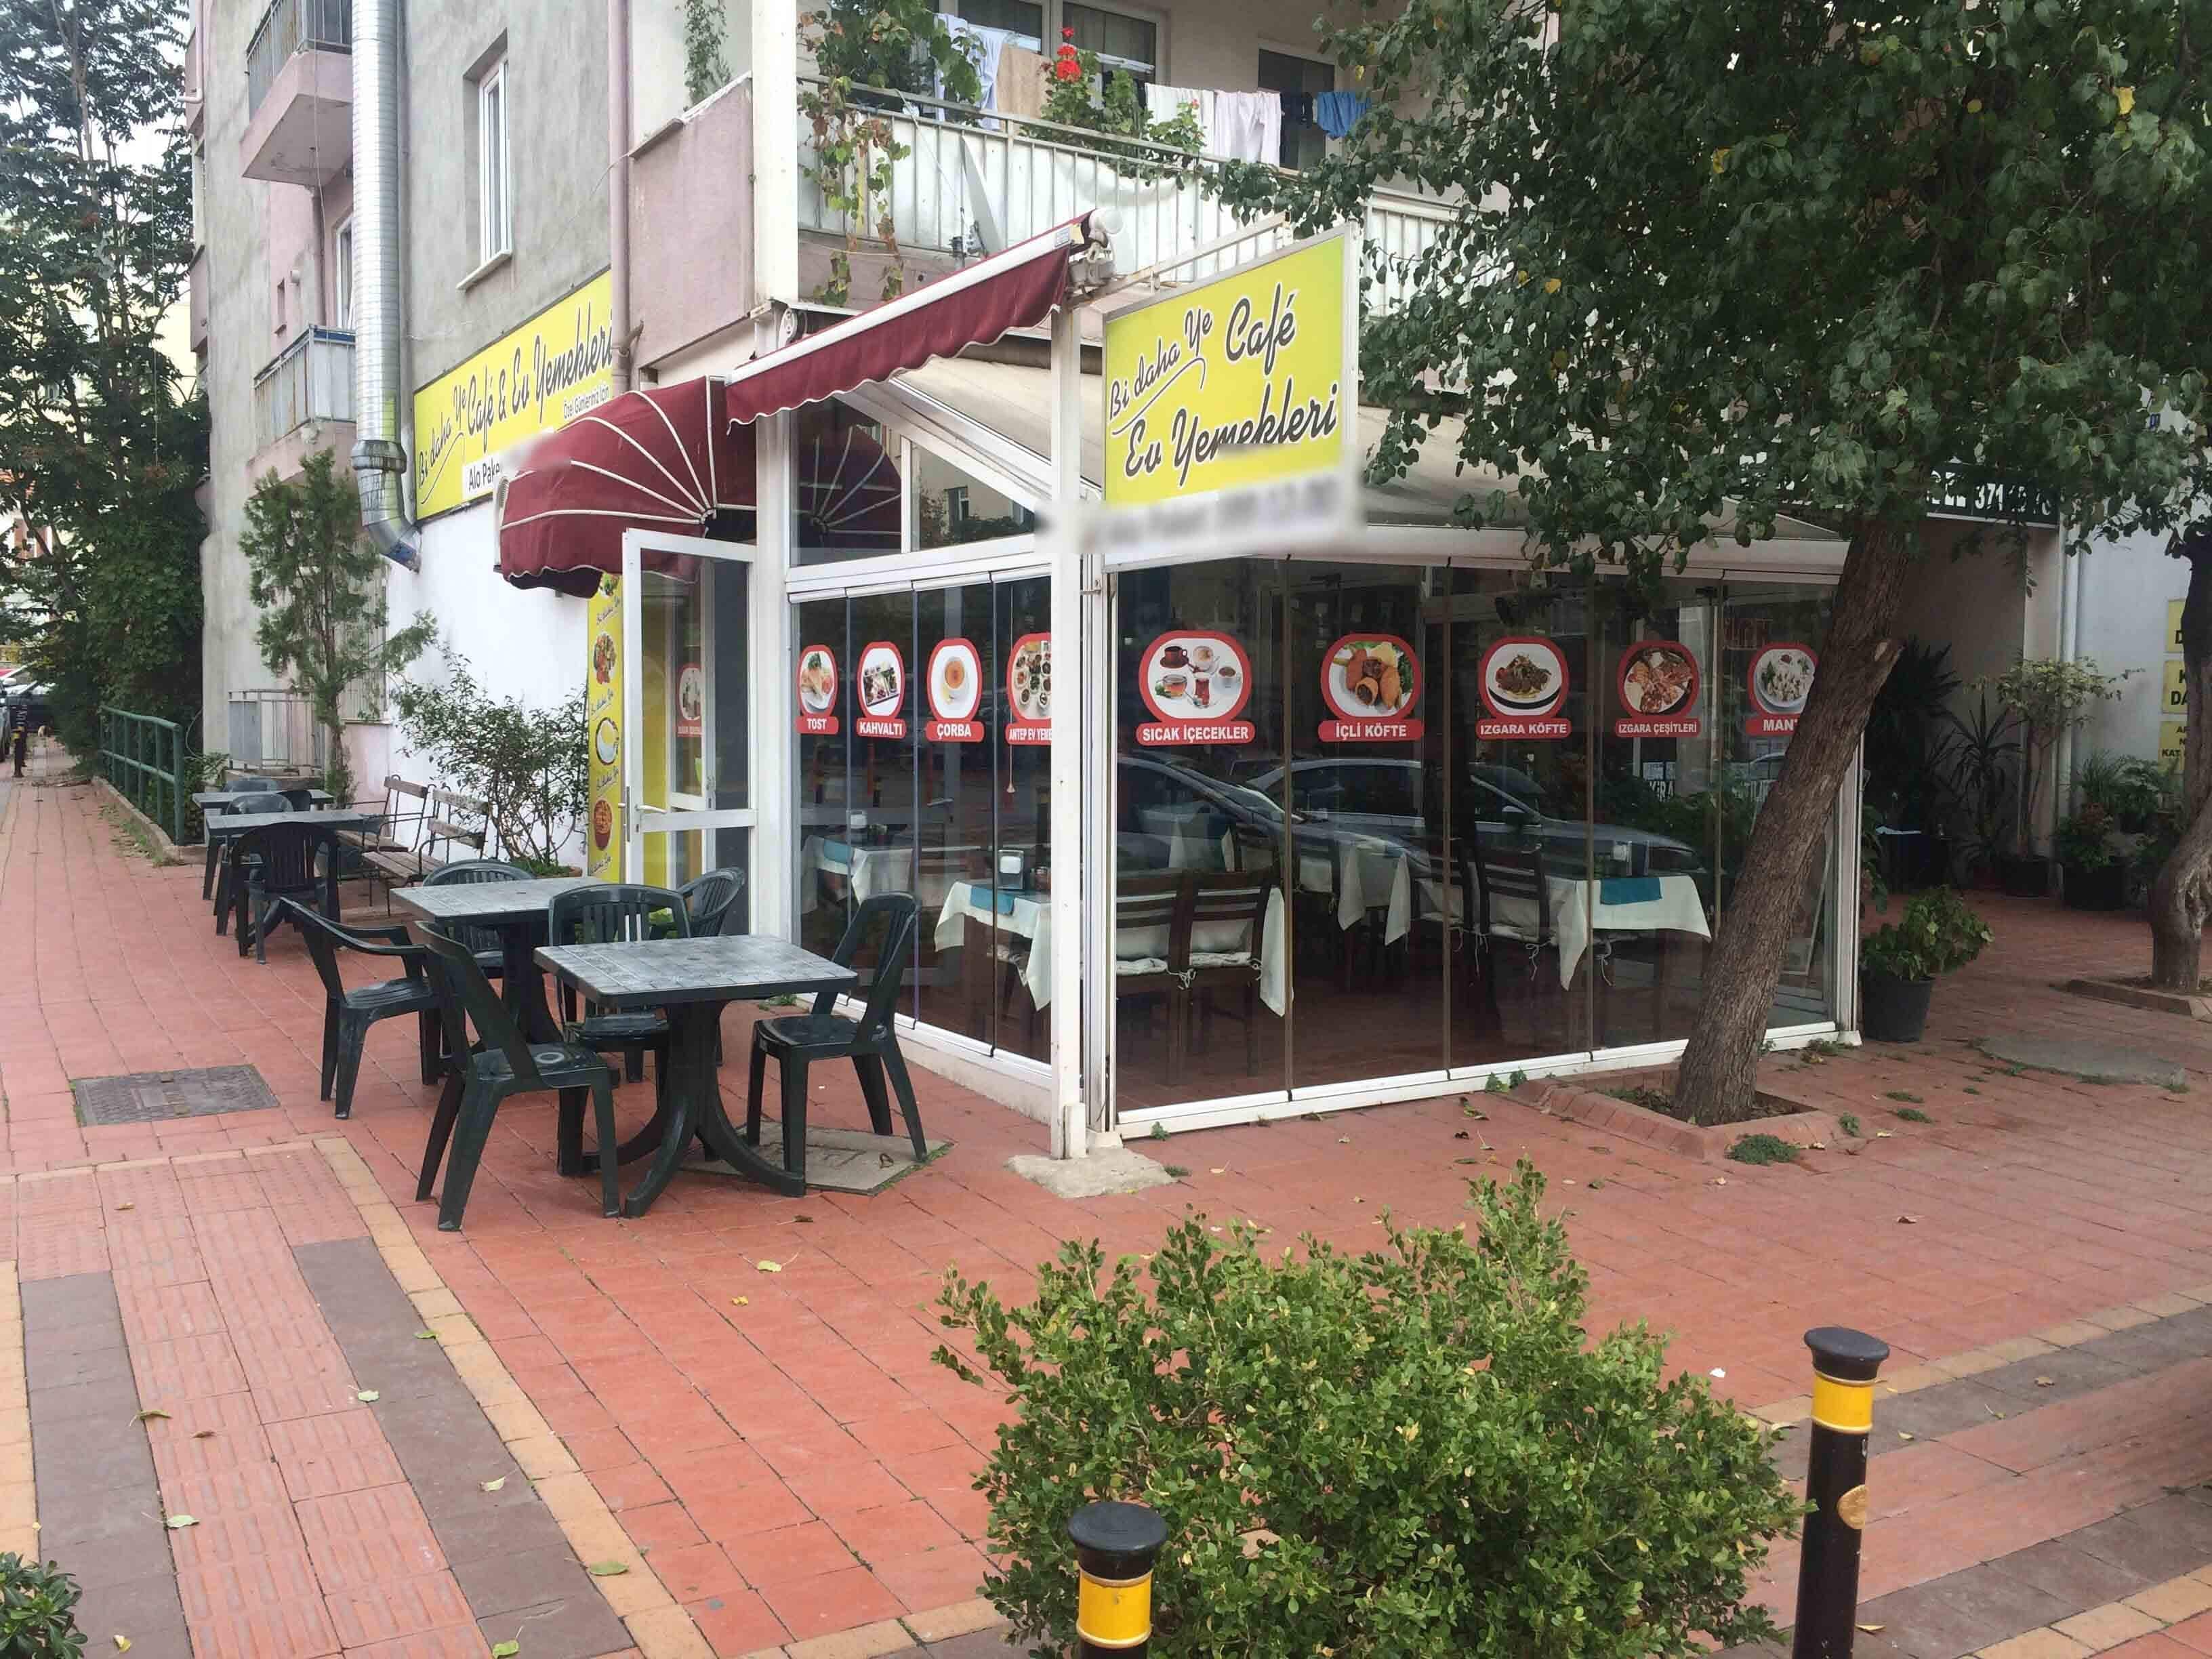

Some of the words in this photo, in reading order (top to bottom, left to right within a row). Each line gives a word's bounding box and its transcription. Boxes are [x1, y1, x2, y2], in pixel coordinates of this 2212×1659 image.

[1109, 380, 1130, 421] Bi
[1134, 336, 1181, 398] daha
[1185, 308, 1212, 357] Ye
[1225, 282, 1296, 375] Café
[430, 411, 452, 467] daha
[453, 384, 467, 430] Ye
[468, 364, 495, 454] Café
[499, 368, 507, 422] &
[512, 346, 530, 414] Ev
[533, 301, 613, 424] Yemekleri
[1125, 417, 1162, 478] Ev
[1172, 377, 1338, 487] Yemekleri
[468, 465, 481, 491] Alo
[806, 718, 827, 731] TOST
[859, 721, 903, 736] KAHVALTI
[937, 723, 972, 739] ÇORBA
[1335, 722, 1361, 739] İÇLİ
[1364, 722, 1408, 738] KÖFTE
[1480, 724, 1525, 735] IZGARA
[1528, 721, 1568, 735] KÖFTE
[1618, 723, 1652, 734] IZGARA
[1653, 721, 1697, 735] ÇEŞİTLERİ
[1763, 718, 1799, 732] MAN
[1008, 728, 1027, 741] ANTEP
[1027, 727, 1036, 741] EV
[1143, 727, 1180, 741] SICAK
[1183, 725, 1249, 743] İÇECEKLER
